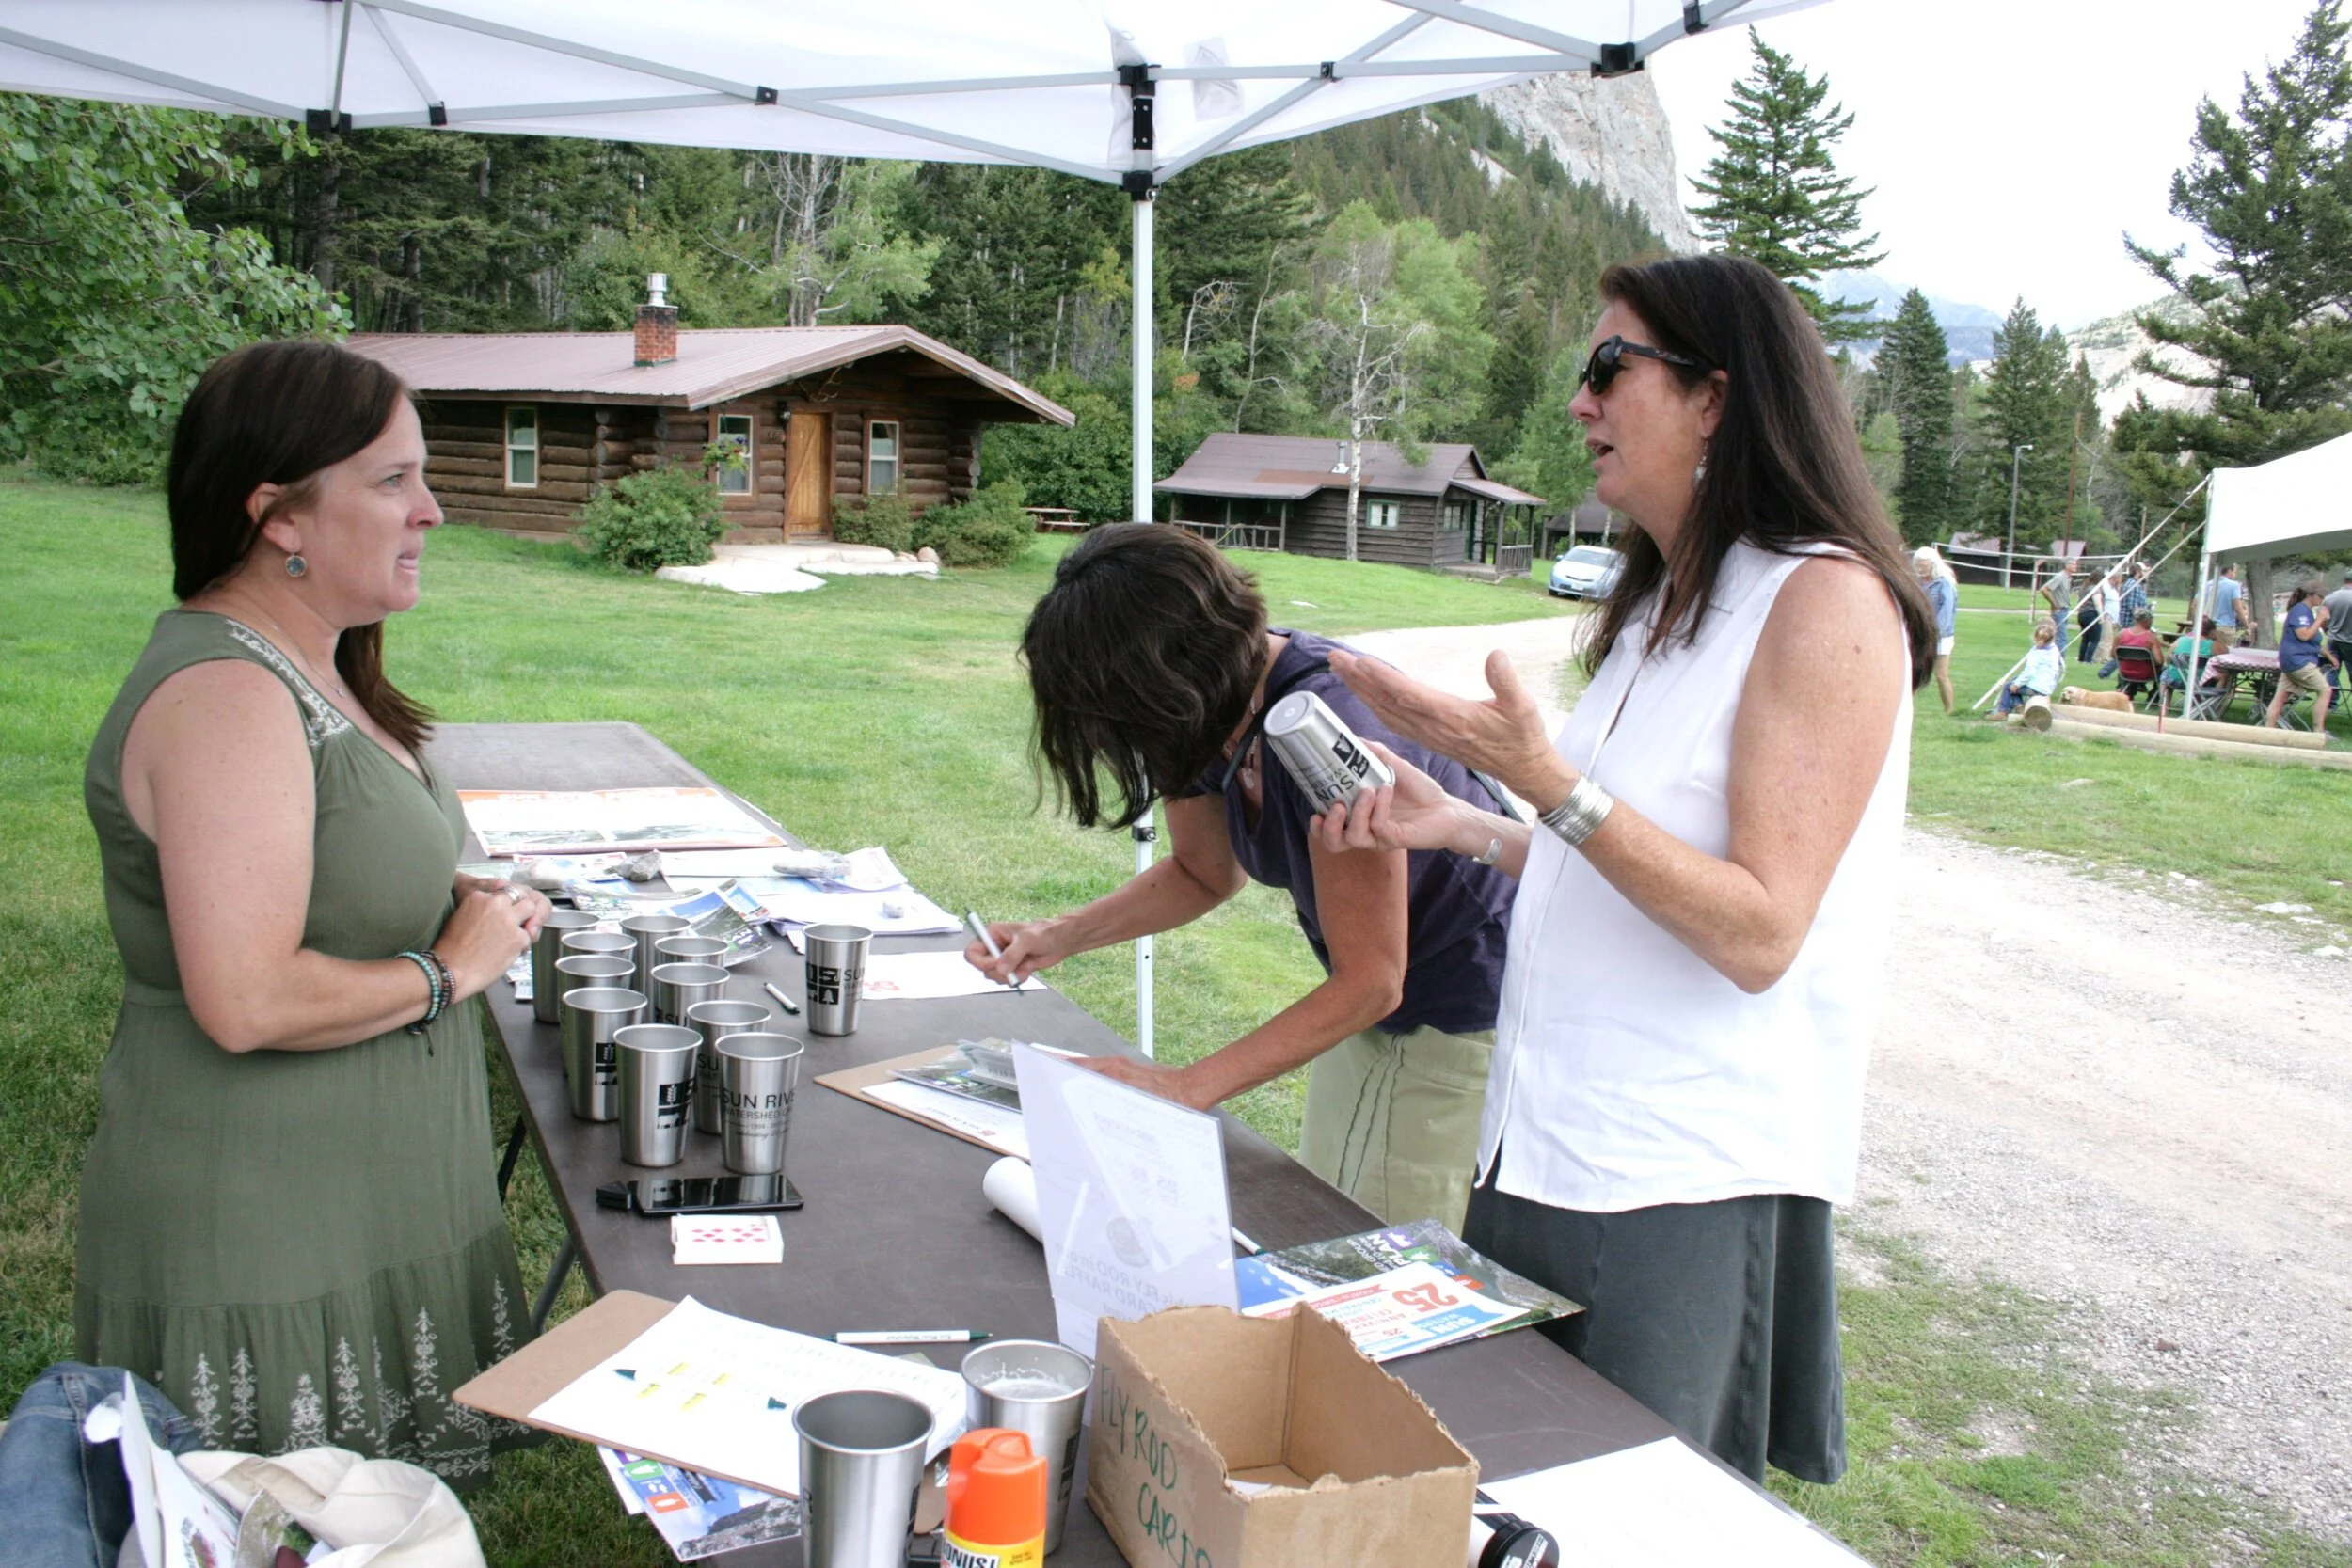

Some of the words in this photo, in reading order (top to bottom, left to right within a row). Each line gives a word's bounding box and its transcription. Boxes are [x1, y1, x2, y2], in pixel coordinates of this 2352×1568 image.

[1314, 774, 1355, 801] SUN
[698, 1053, 719, 1071] SU
[722, 1087, 757, 1109] SUN
[1366, 1233, 1412, 1267] PLAN
[1391, 1282, 1459, 1313] 25
[1100, 1363, 1129, 1455] FLY
[1134, 1406, 1177, 1491] ROD
